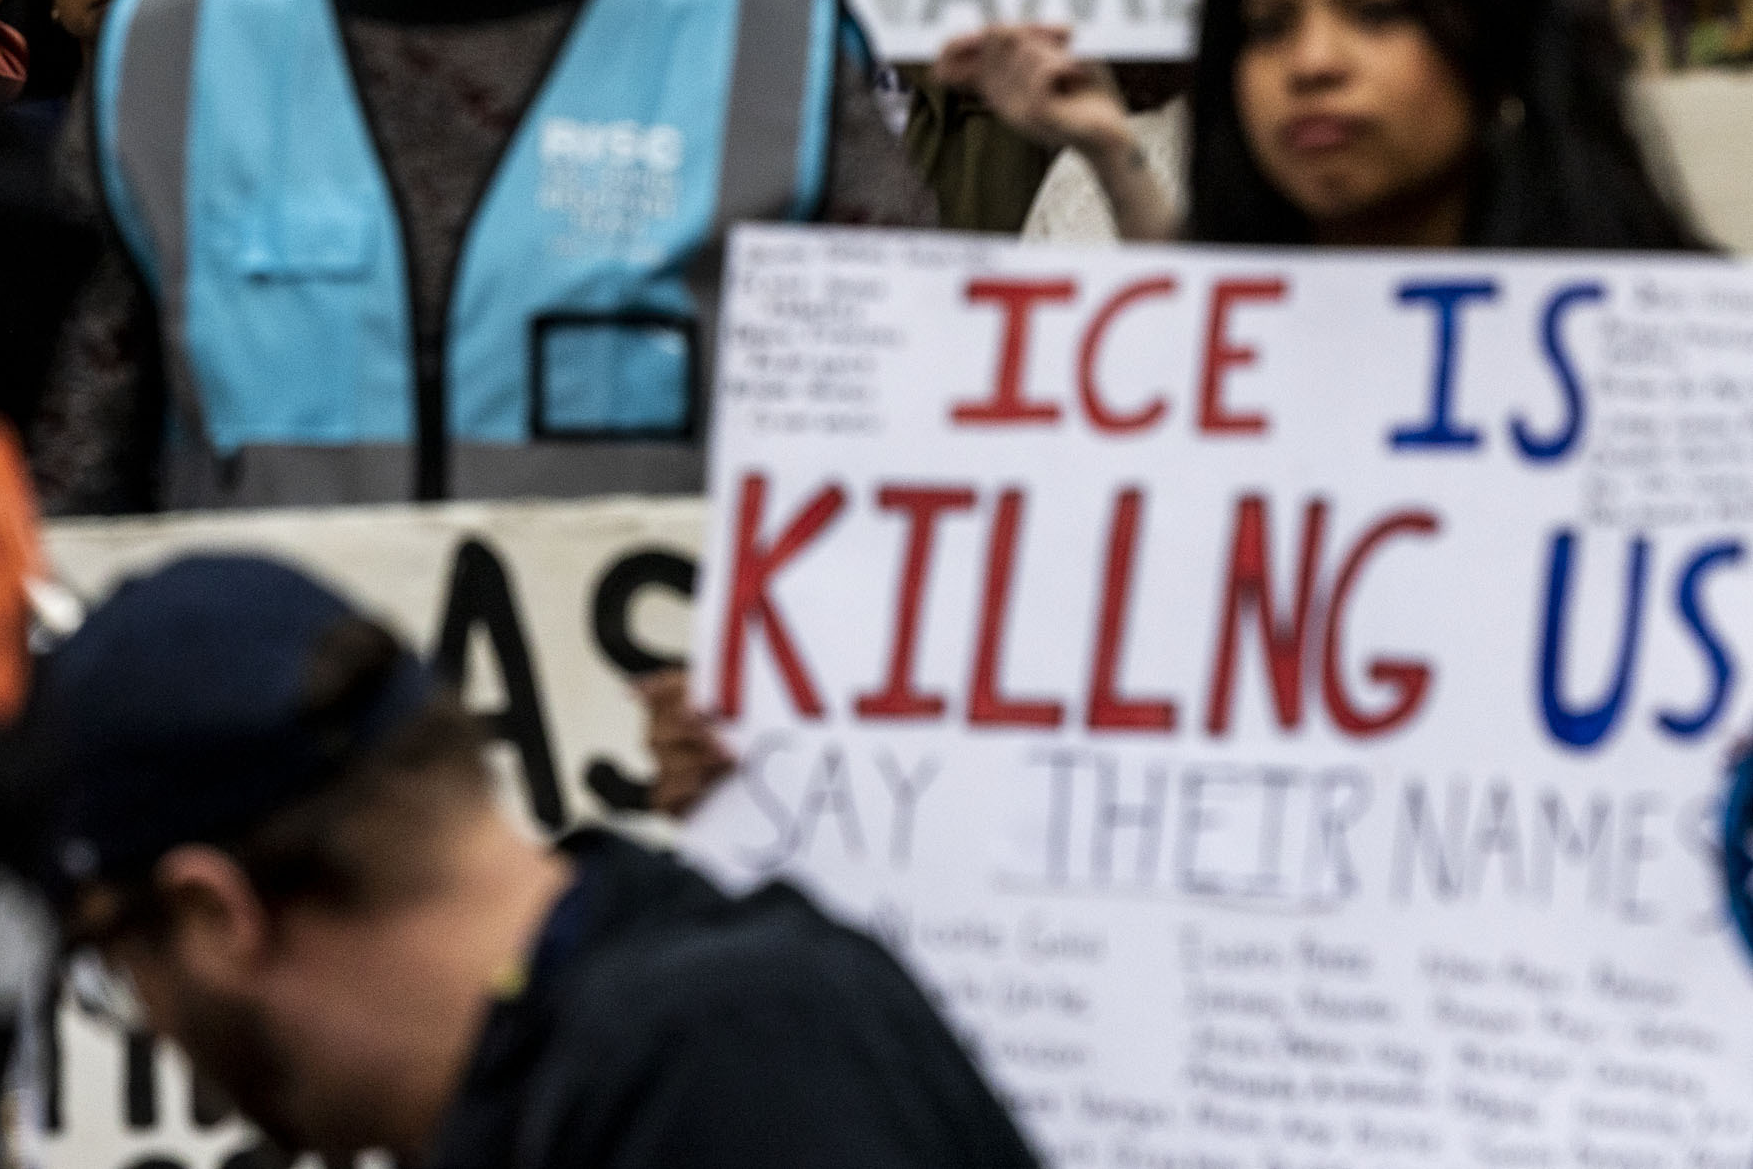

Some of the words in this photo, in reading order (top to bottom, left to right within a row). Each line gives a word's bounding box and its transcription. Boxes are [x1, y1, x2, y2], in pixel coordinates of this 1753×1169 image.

[949, 277, 1290, 436] ICE
[1388, 280, 1608, 464] IS
[715, 471, 1442, 739] KILLNG
[1535, 528, 1748, 751] US
[739, 730, 941, 874] SAY
[1026, 746, 1372, 905] THEIR
